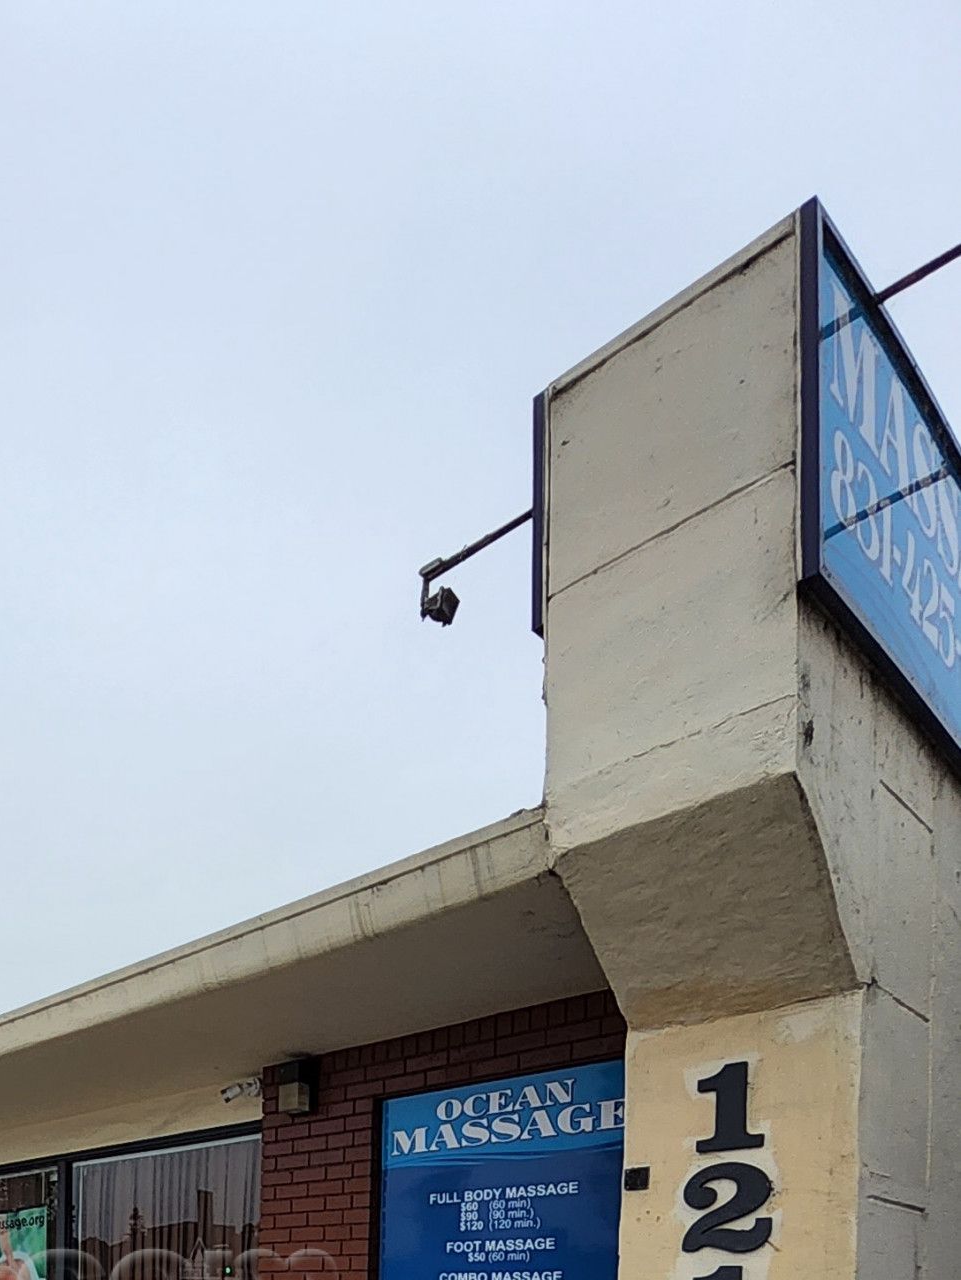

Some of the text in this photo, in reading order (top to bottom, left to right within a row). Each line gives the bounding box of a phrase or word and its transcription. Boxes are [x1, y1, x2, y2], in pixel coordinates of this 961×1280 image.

[829, 281, 961, 592] MASS
[436, 1078, 575, 1121] OCEAN
[391, 1099, 626, 1156] MASSAGE
[429, 1181, 579, 1205] FULL BODY MASSAGE
[460, 1198, 531, 1212] $60 (60 min)
[460, 1208, 535, 1222] $90 (90 min.)
[459, 1217, 541, 1232] $120 (120 min.)
[446, 1237, 556, 1253] FOOT MASSAGE
[467, 1251, 530, 1264] $50 (60 min)
